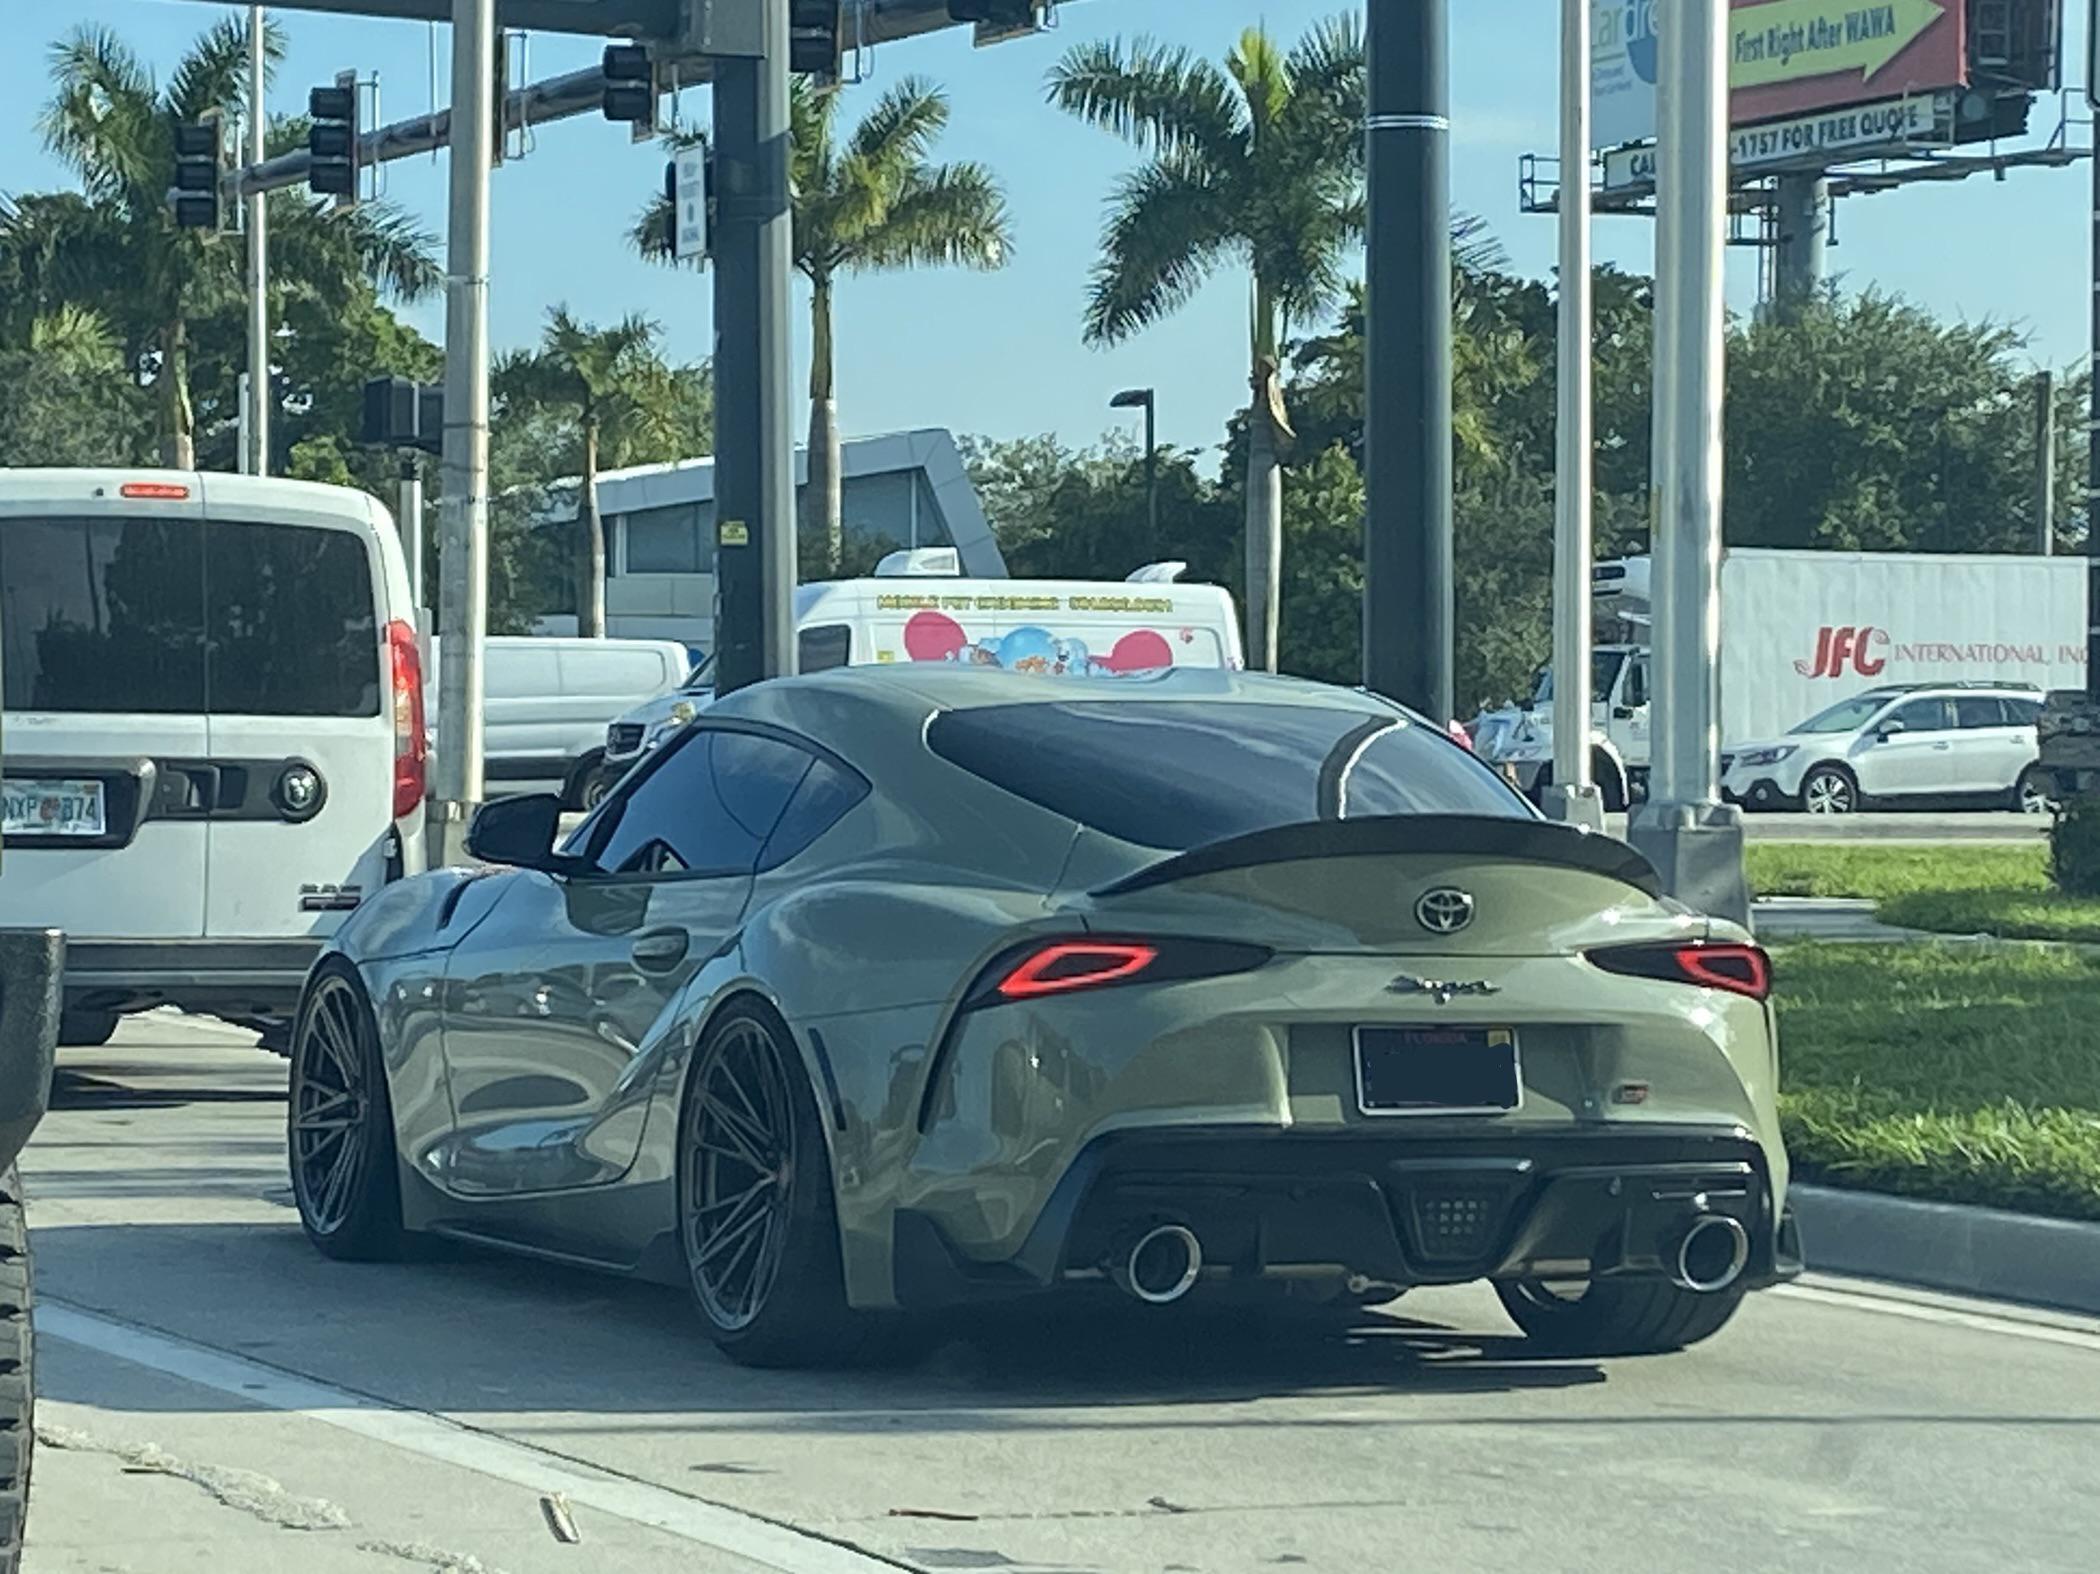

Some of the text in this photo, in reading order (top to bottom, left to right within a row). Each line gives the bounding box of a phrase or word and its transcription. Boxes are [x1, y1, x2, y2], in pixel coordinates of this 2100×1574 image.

[1735, 5, 1896, 66] First Right After WAWA
[1782, 125, 1813, 151] FOR
[1818, 116, 1856, 147] FREE
[1794, 626, 1890, 679] JFC
